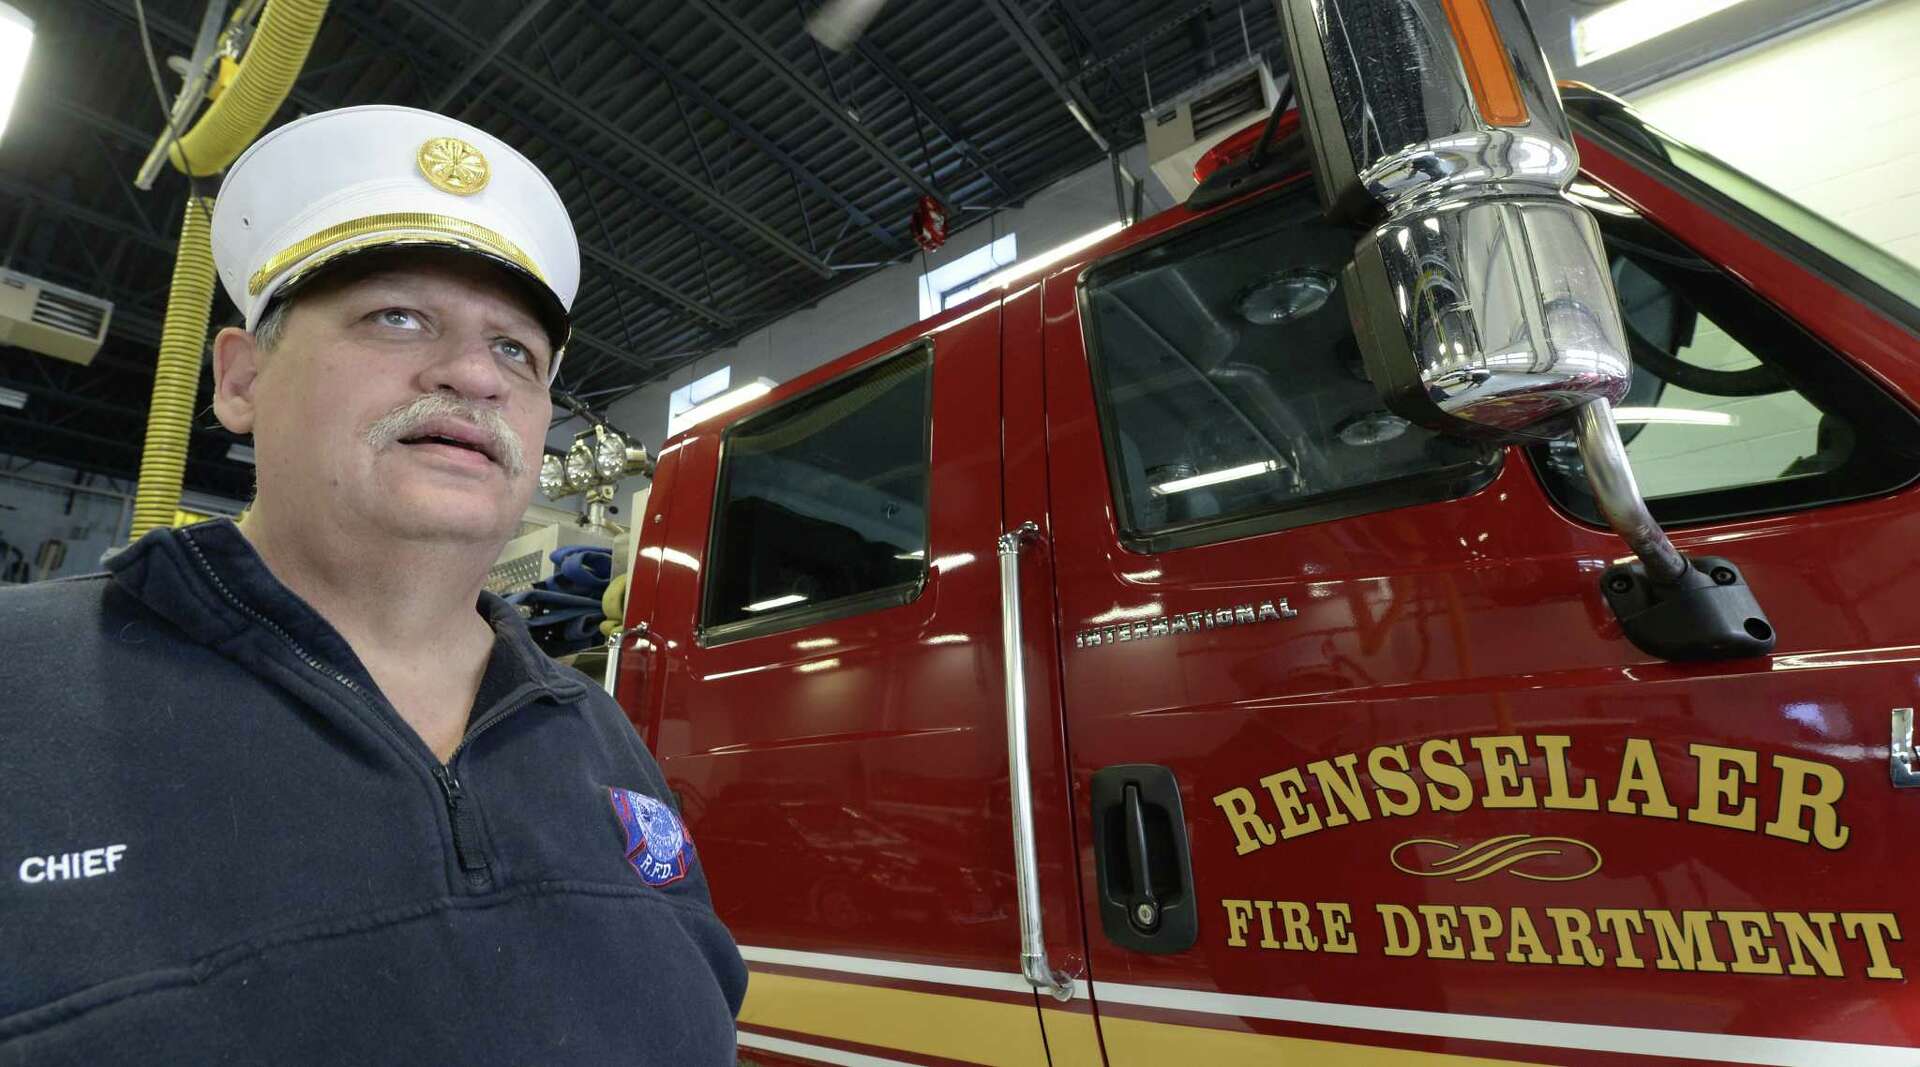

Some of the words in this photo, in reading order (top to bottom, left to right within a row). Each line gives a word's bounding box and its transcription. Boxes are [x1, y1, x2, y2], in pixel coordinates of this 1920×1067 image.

[1076, 598, 1297, 648] INTERNATIONAL
[1214, 735, 1851, 851] RENSSELAER
[19, 844, 127, 883] CHIEF
[640, 853, 673, 879] R.F.D.
[1222, 899, 1357, 955] FIRE
[1376, 904, 1904, 980] DEPARTMENT
